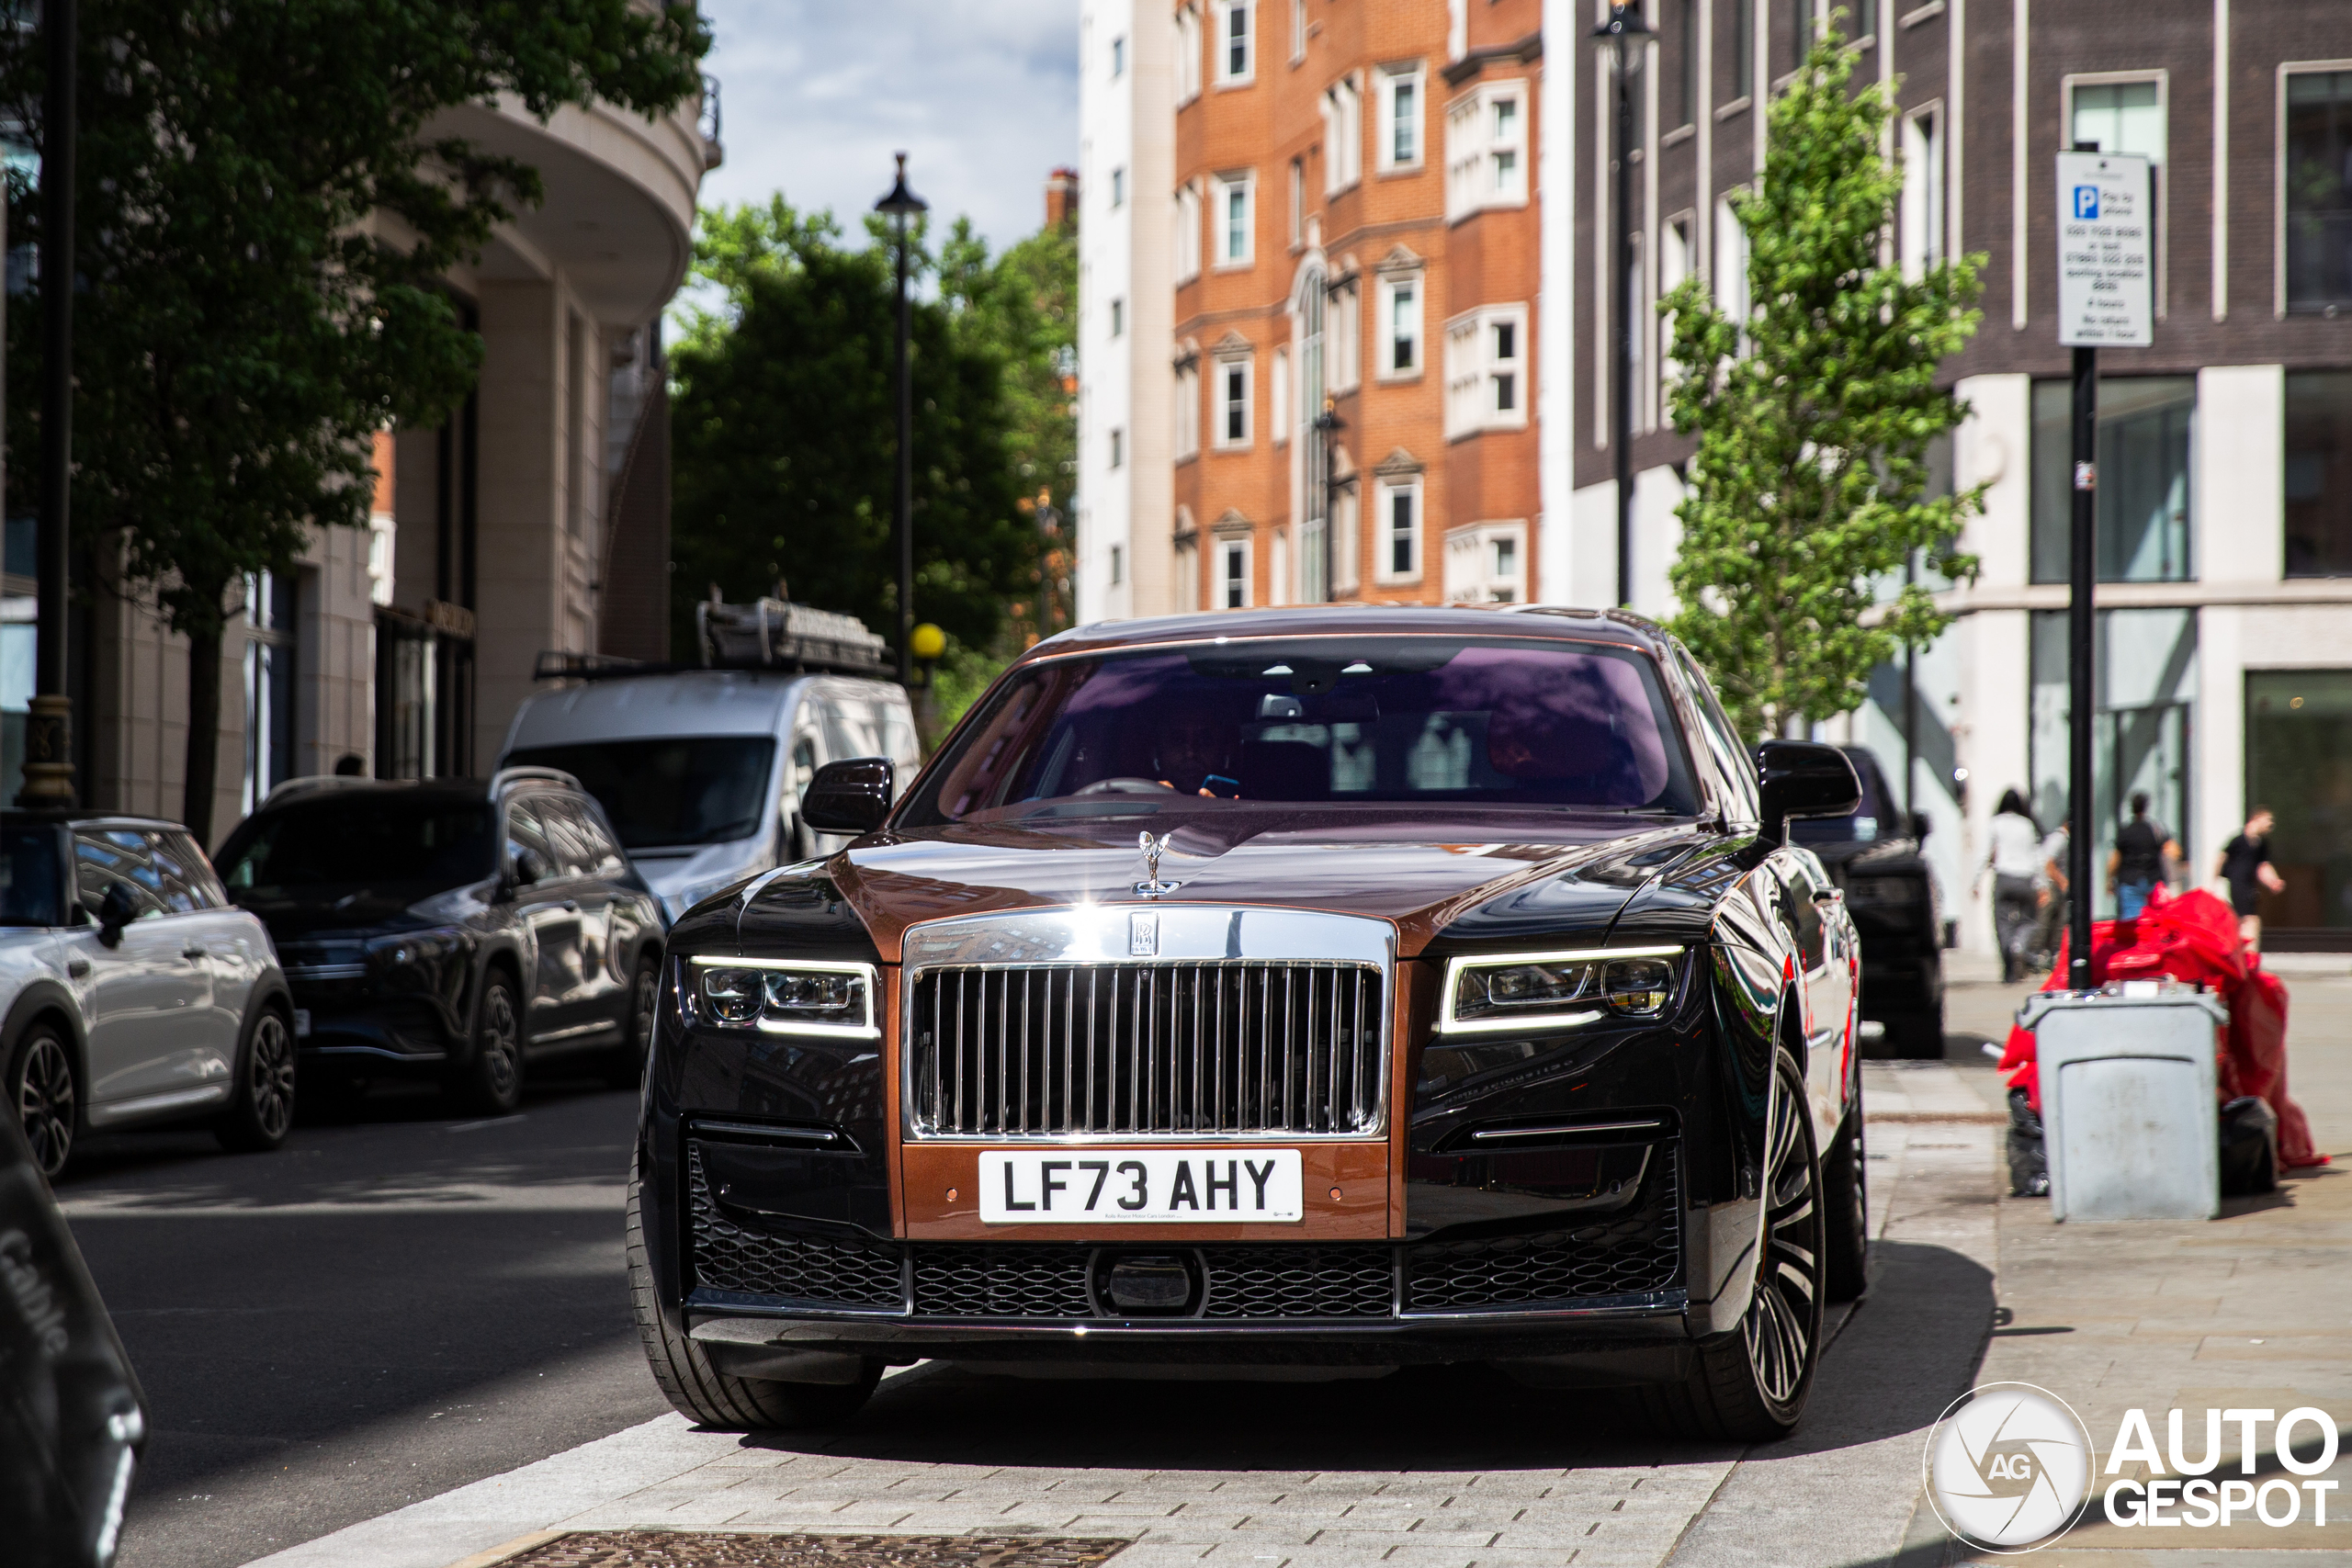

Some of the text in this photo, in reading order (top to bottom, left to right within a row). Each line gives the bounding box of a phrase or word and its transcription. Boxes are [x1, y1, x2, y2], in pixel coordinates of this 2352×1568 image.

[2080, 187, 2096, 218] P
[1004, 1159, 1275, 1211] LF73 AHY
